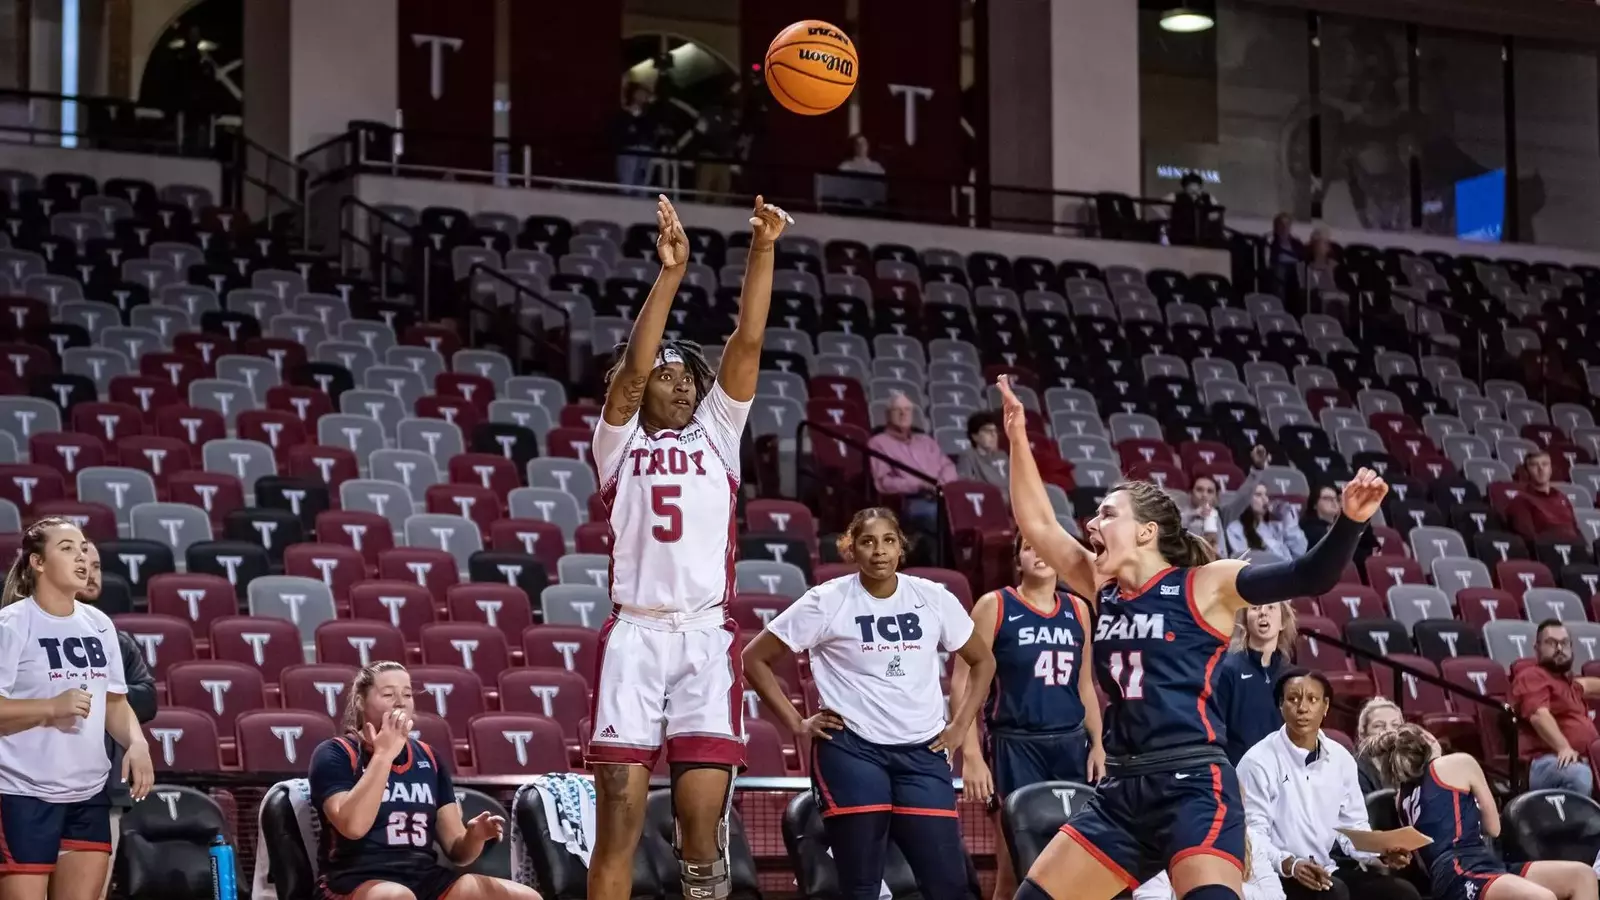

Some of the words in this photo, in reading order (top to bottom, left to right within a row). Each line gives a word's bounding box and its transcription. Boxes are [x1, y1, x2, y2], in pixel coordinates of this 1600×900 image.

[411, 33, 463, 100] T
[799, 48, 853, 77] Wilson
[888, 84, 934, 147] T
[15, 411, 36, 435] T
[98, 415, 119, 440] T
[180, 419, 202, 443] T
[262, 423, 283, 447] T
[57, 446, 80, 471] T
[422, 433, 441, 457] T
[144, 450, 166, 474] T
[230, 453, 250, 478] T
[313, 458, 335, 482] T
[629, 446, 707, 476] TROY
[13, 477, 37, 504] T
[395, 463, 417, 491] T
[106, 483, 130, 508] T
[195, 485, 218, 511] T
[283, 490, 305, 515] T
[651, 485, 683, 543] 5
[160, 520, 184, 546] T
[253, 522, 277, 548] T
[343, 525, 366, 551] T
[119, 554, 145, 583] T
[217, 556, 242, 585] T
[312, 558, 338, 587] T
[407, 563, 432, 587] T
[178, 590, 205, 620] T
[280, 594, 306, 623] T
[379, 597, 406, 627] T
[476, 601, 502, 627] T
[571, 602, 594, 627] T
[855, 612, 923, 643] TCB
[38, 636, 108, 669] TCB
[134, 634, 163, 666] T
[241, 633, 270, 665] T
[348, 637, 375, 668] T
[451, 640, 478, 670] T
[553, 642, 579, 671] T
[1370, 632, 1389, 656] T
[1439, 632, 1458, 658] T
[1034, 650, 1074, 686] 45
[201, 680, 231, 715] T
[314, 682, 344, 716] T
[424, 684, 454, 718] T
[531, 686, 559, 717] T
[150, 728, 183, 766] T
[271, 727, 302, 763] T
[502, 731, 534, 766] T
[157, 792, 180, 820] T
[1052, 789, 1075, 817] T
[1545, 795, 1565, 821] T
[387, 811, 428, 847] 23
